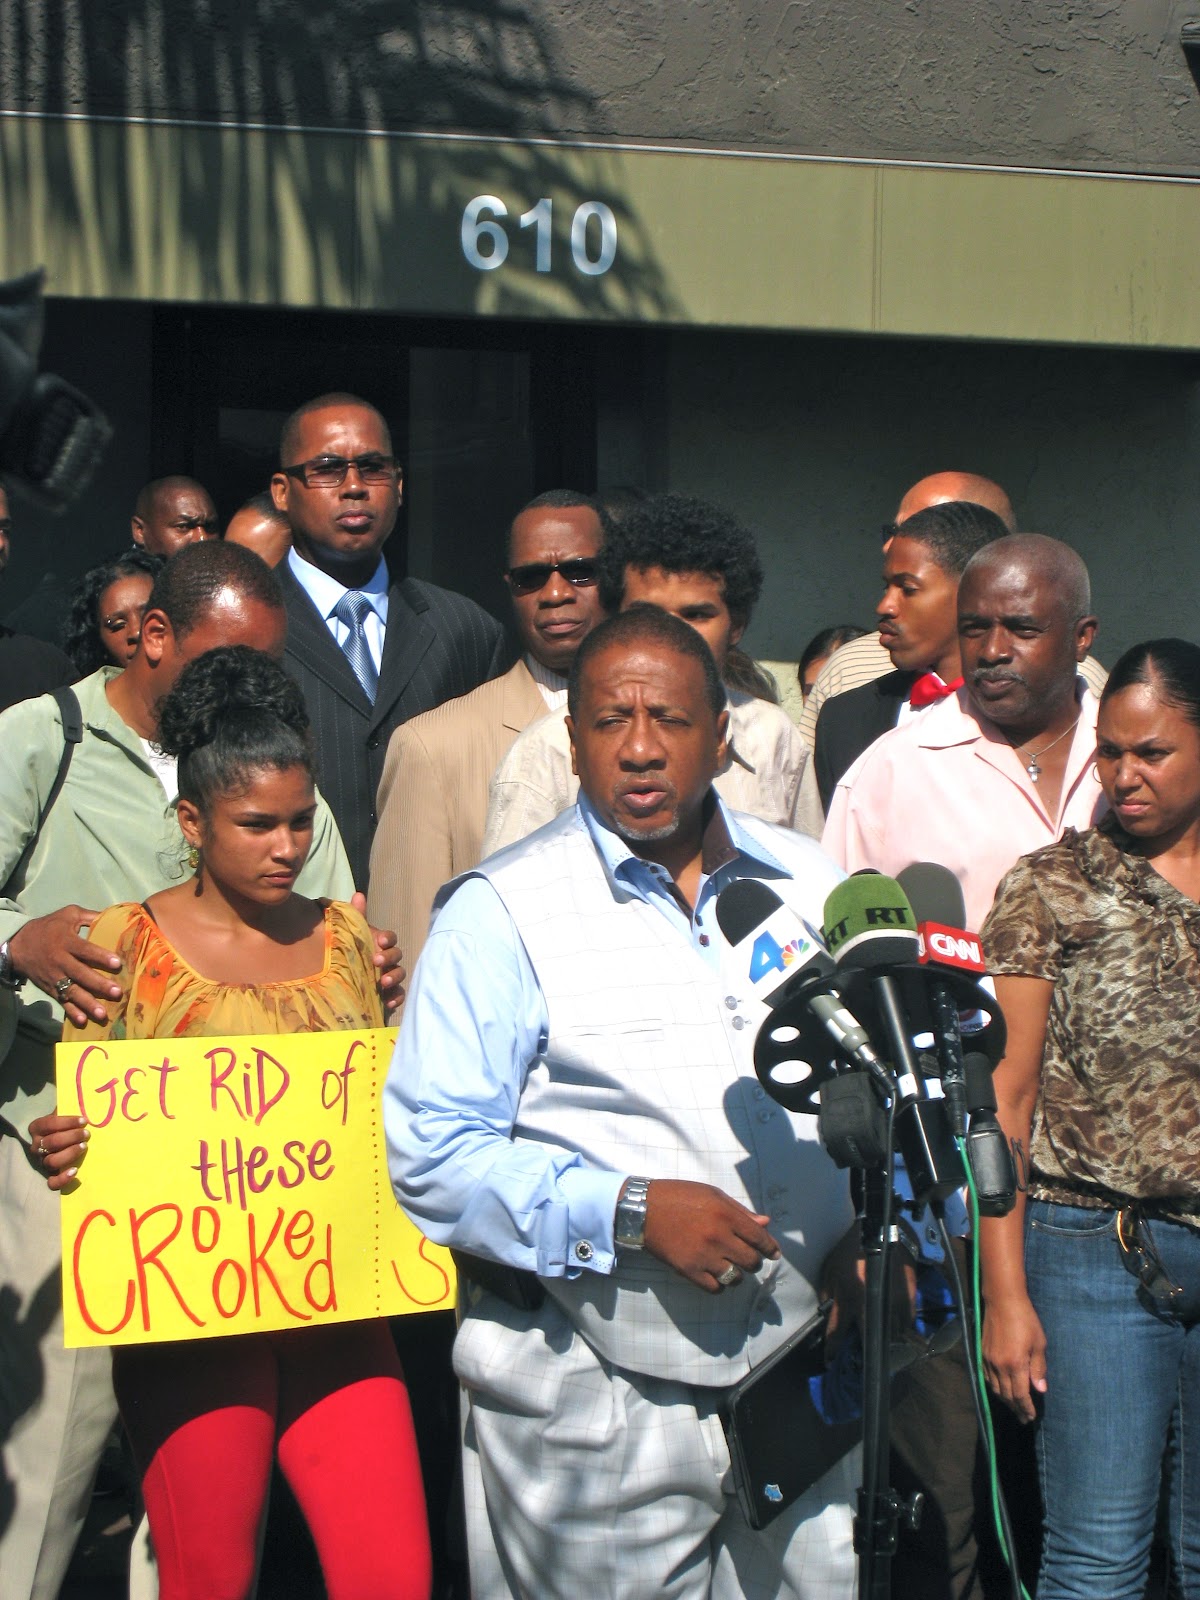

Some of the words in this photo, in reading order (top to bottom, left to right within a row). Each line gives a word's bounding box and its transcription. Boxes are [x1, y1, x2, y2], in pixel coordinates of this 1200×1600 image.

[461, 194, 618, 275] 610
[865, 907, 908, 924] RT
[748, 930, 787, 984] 4
[930, 933, 981, 963] CNN
[321, 1040, 367, 1125] of
